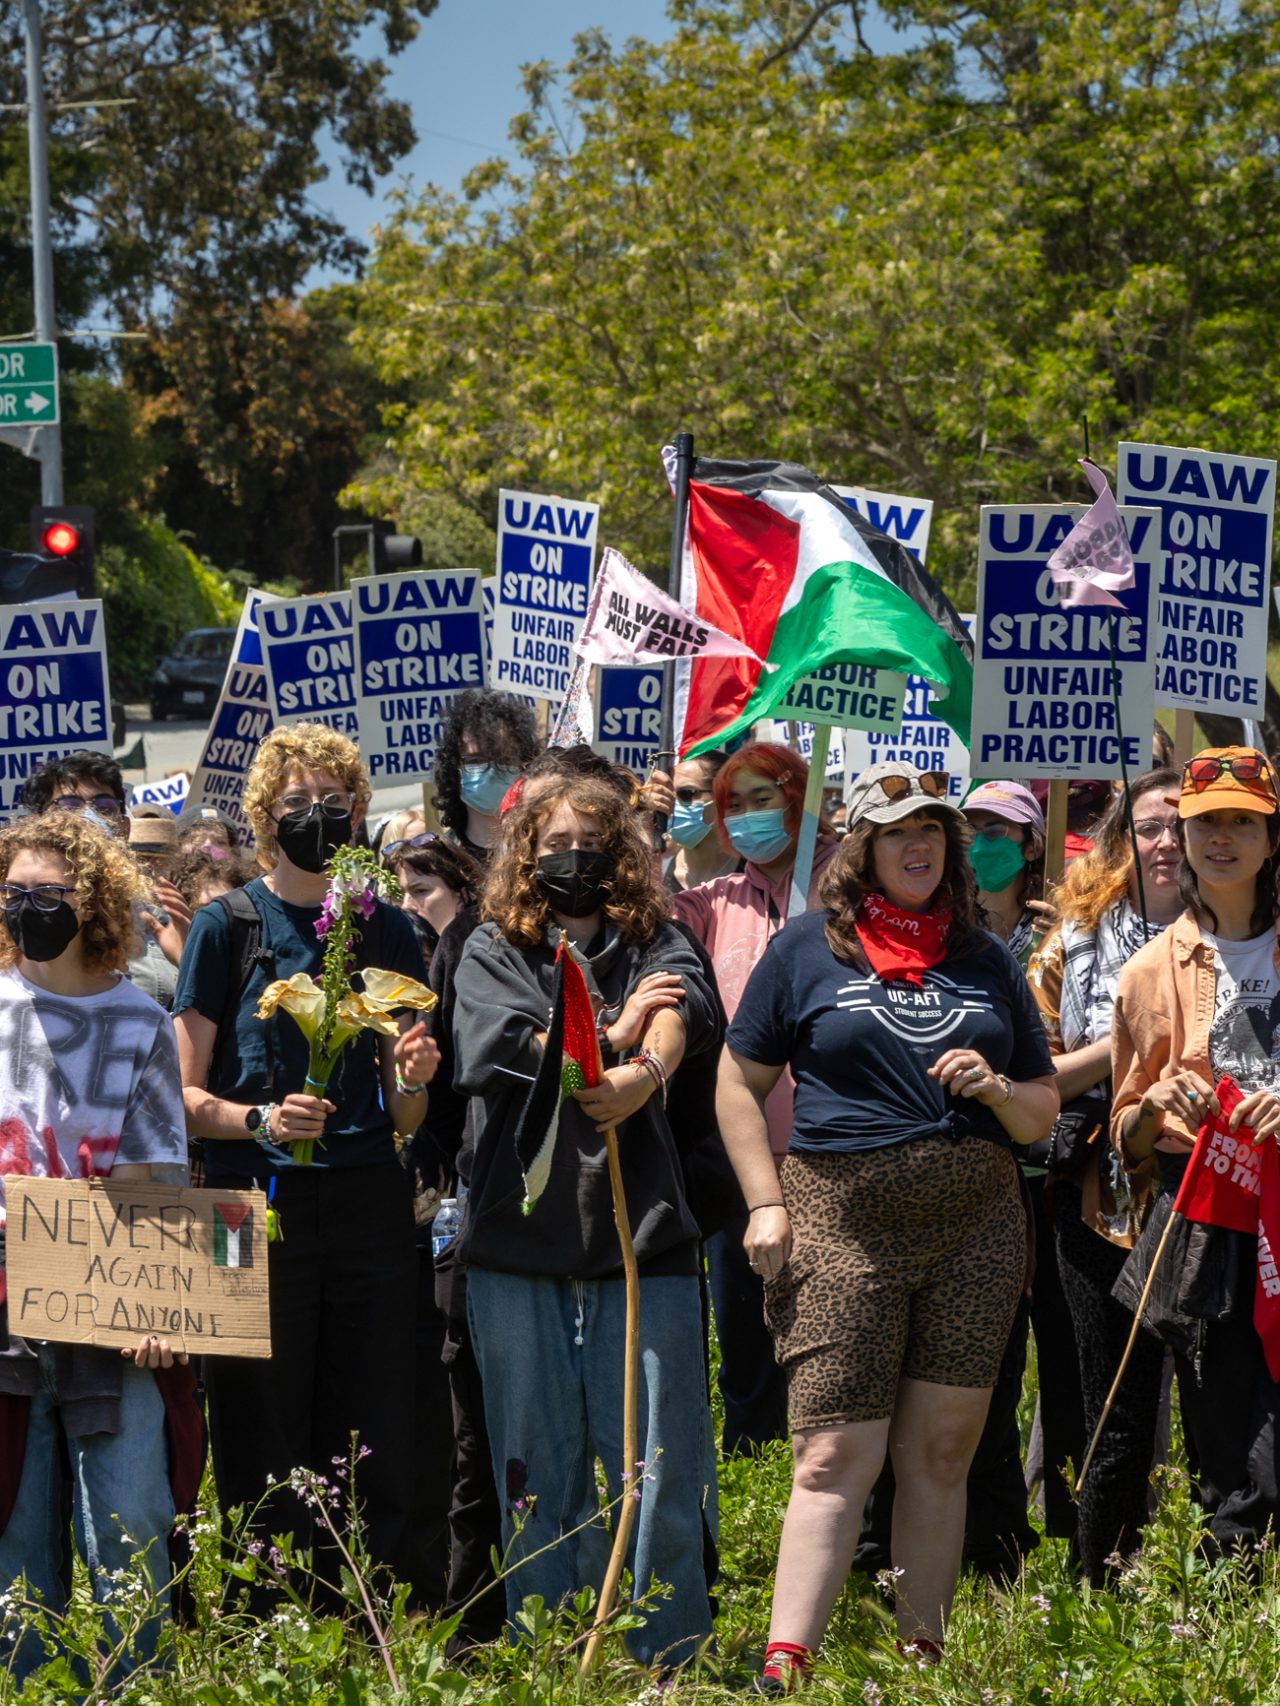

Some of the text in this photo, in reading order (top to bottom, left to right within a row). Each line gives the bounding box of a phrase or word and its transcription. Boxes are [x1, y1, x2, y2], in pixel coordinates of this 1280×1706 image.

[0, 393, 17, 416] R
[1127, 453, 1270, 505] UAW
[505, 498, 595, 540] UAW
[1169, 510, 1221, 550] ON
[530, 543, 563, 575] ON
[1160, 550, 1260, 599] TRIKE
[358, 576, 477, 616] UAW
[502, 571, 587, 612] STRIKE
[0, 609, 98, 651] AW
[395, 620, 442, 653] ON
[604, 611, 641, 643] MUST
[609, 591, 710, 647] ALL WALLS
[987, 613, 1142, 653] STRIKE
[1158, 600, 1244, 639] NFAIR
[306, 640, 354, 673] ON
[511, 616, 575, 662] UNFAIR
[513, 636, 571, 673] LABOR
[1156, 633, 1238, 670] ABOR
[8, 662, 61, 699] ON
[228, 670, 268, 702] UA
[365, 653, 480, 690] STRIKE
[497, 664, 572, 697] PRACTIC
[1003, 666, 1122, 697] UNFAIR
[1155, 663, 1258, 706] ACTICE
[280, 673, 355, 710] STRI
[638, 675, 660, 704] O
[0, 700, 102, 740] TRIKE
[380, 698, 455, 723] UNFA
[603, 707, 661, 737] STR
[1008, 700, 1117, 731] LABOR
[386, 721, 447, 749] LABO
[980, 734, 1140, 766] PRACTICE
[369, 749, 434, 777] PRAC
[204, 773, 243, 798] UNFA
[887, 989, 941, 1006] UC-AFT
[1216, 979, 1269, 1009] TRIKE!
[894, 1007, 942, 1018] STUDENT SUCCESS
[1204, 1148, 1231, 1175] TO
[21, 1194, 198, 1254] NEVER
[21, 1287, 224, 1338] FOR ANYONE
